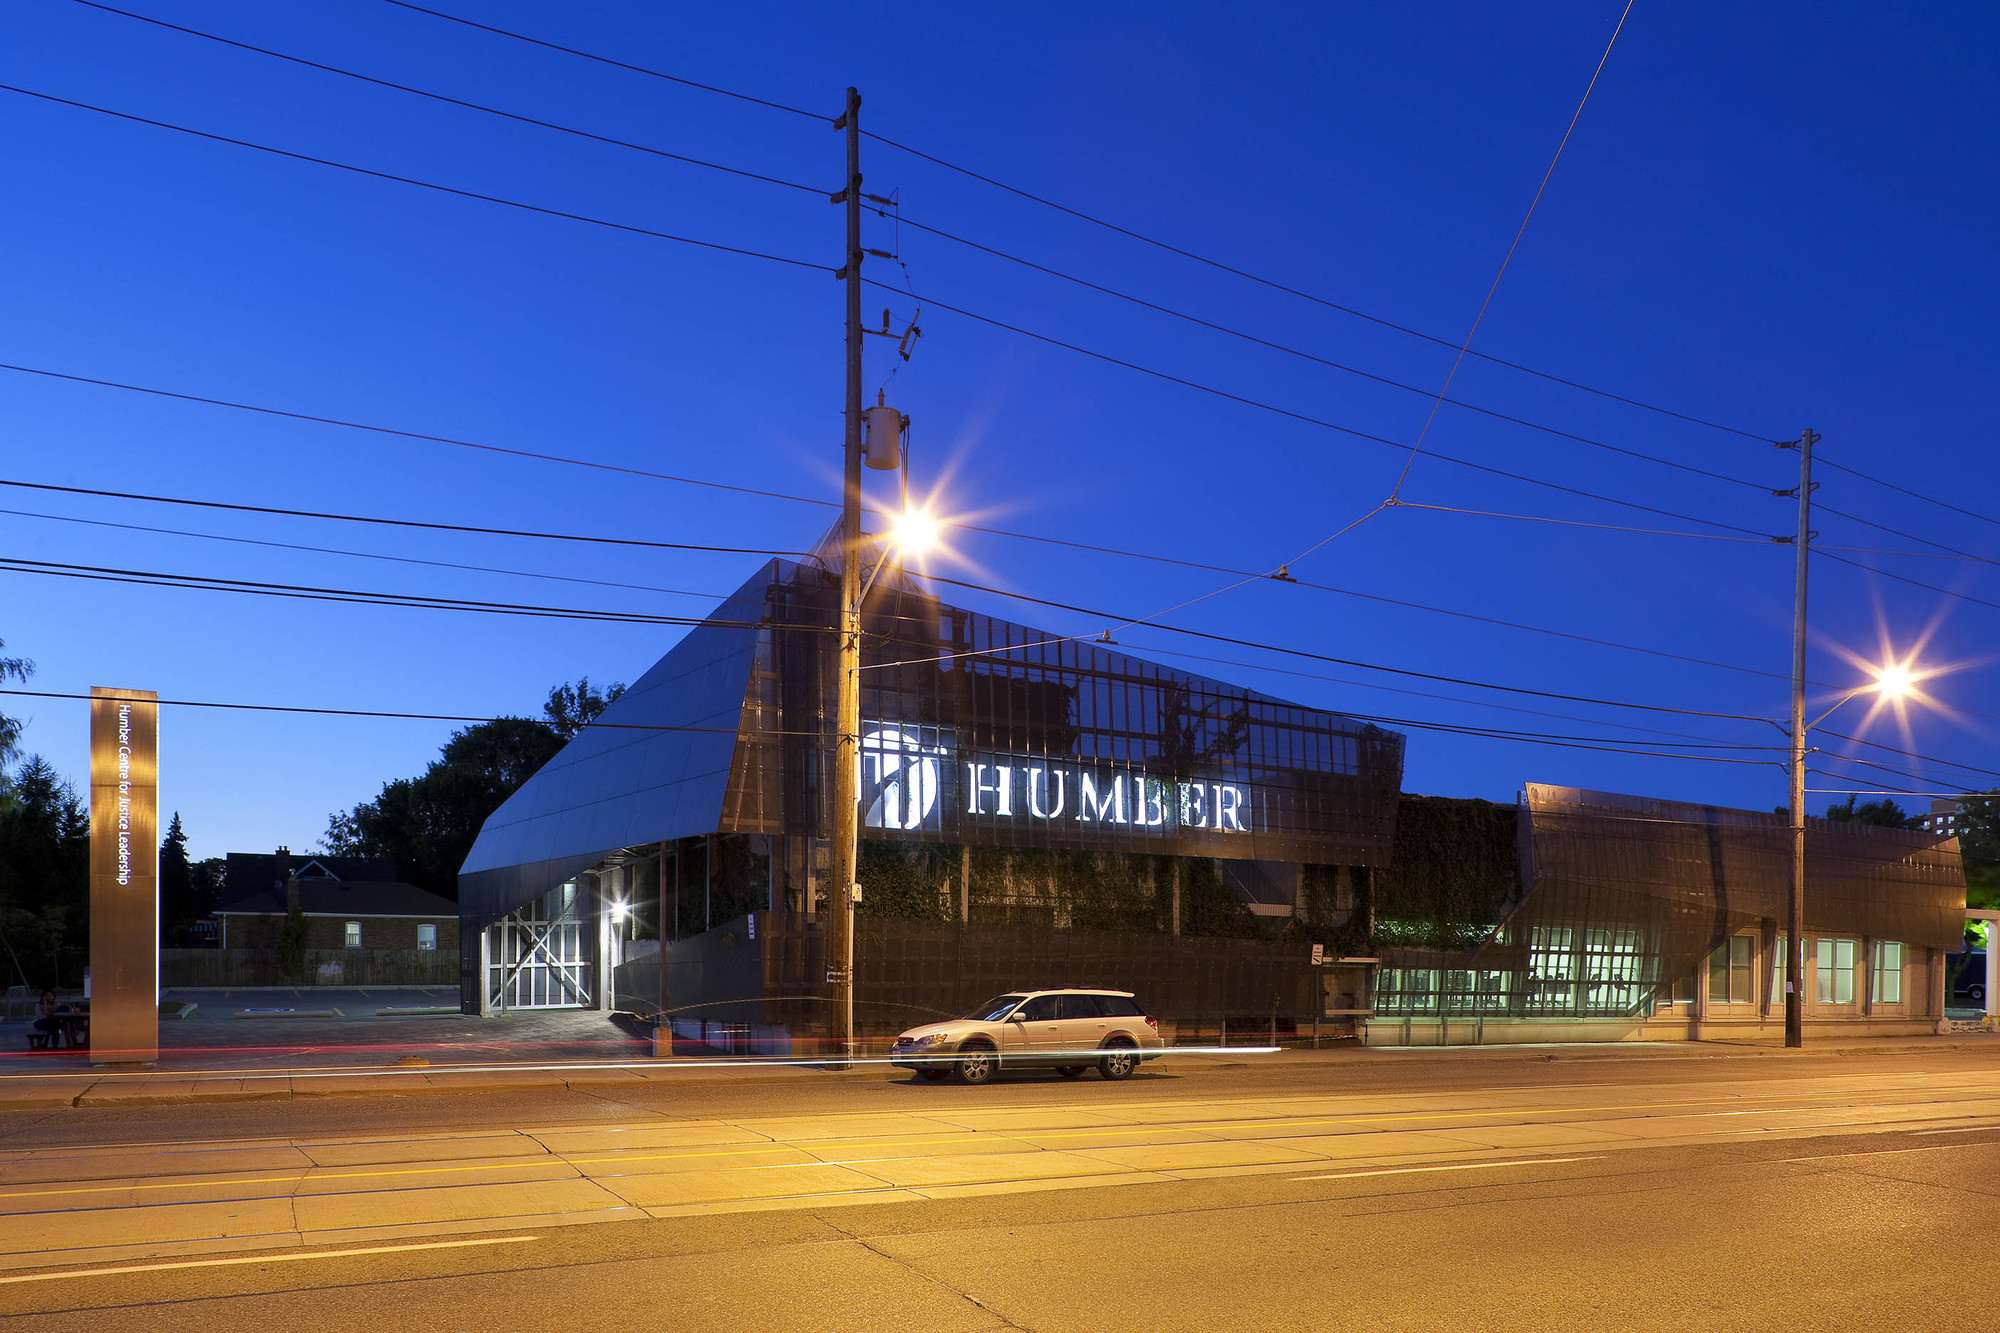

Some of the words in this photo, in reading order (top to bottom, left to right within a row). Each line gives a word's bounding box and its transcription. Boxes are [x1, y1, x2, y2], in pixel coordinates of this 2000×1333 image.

[119, 704, 132, 745] Humber
[118, 746, 132, 779] Centre
[118, 780, 133, 796] for
[967, 761, 1247, 832] HUMBER
[118, 796, 132, 829] Justice
[116, 831, 132, 885] Leadership
